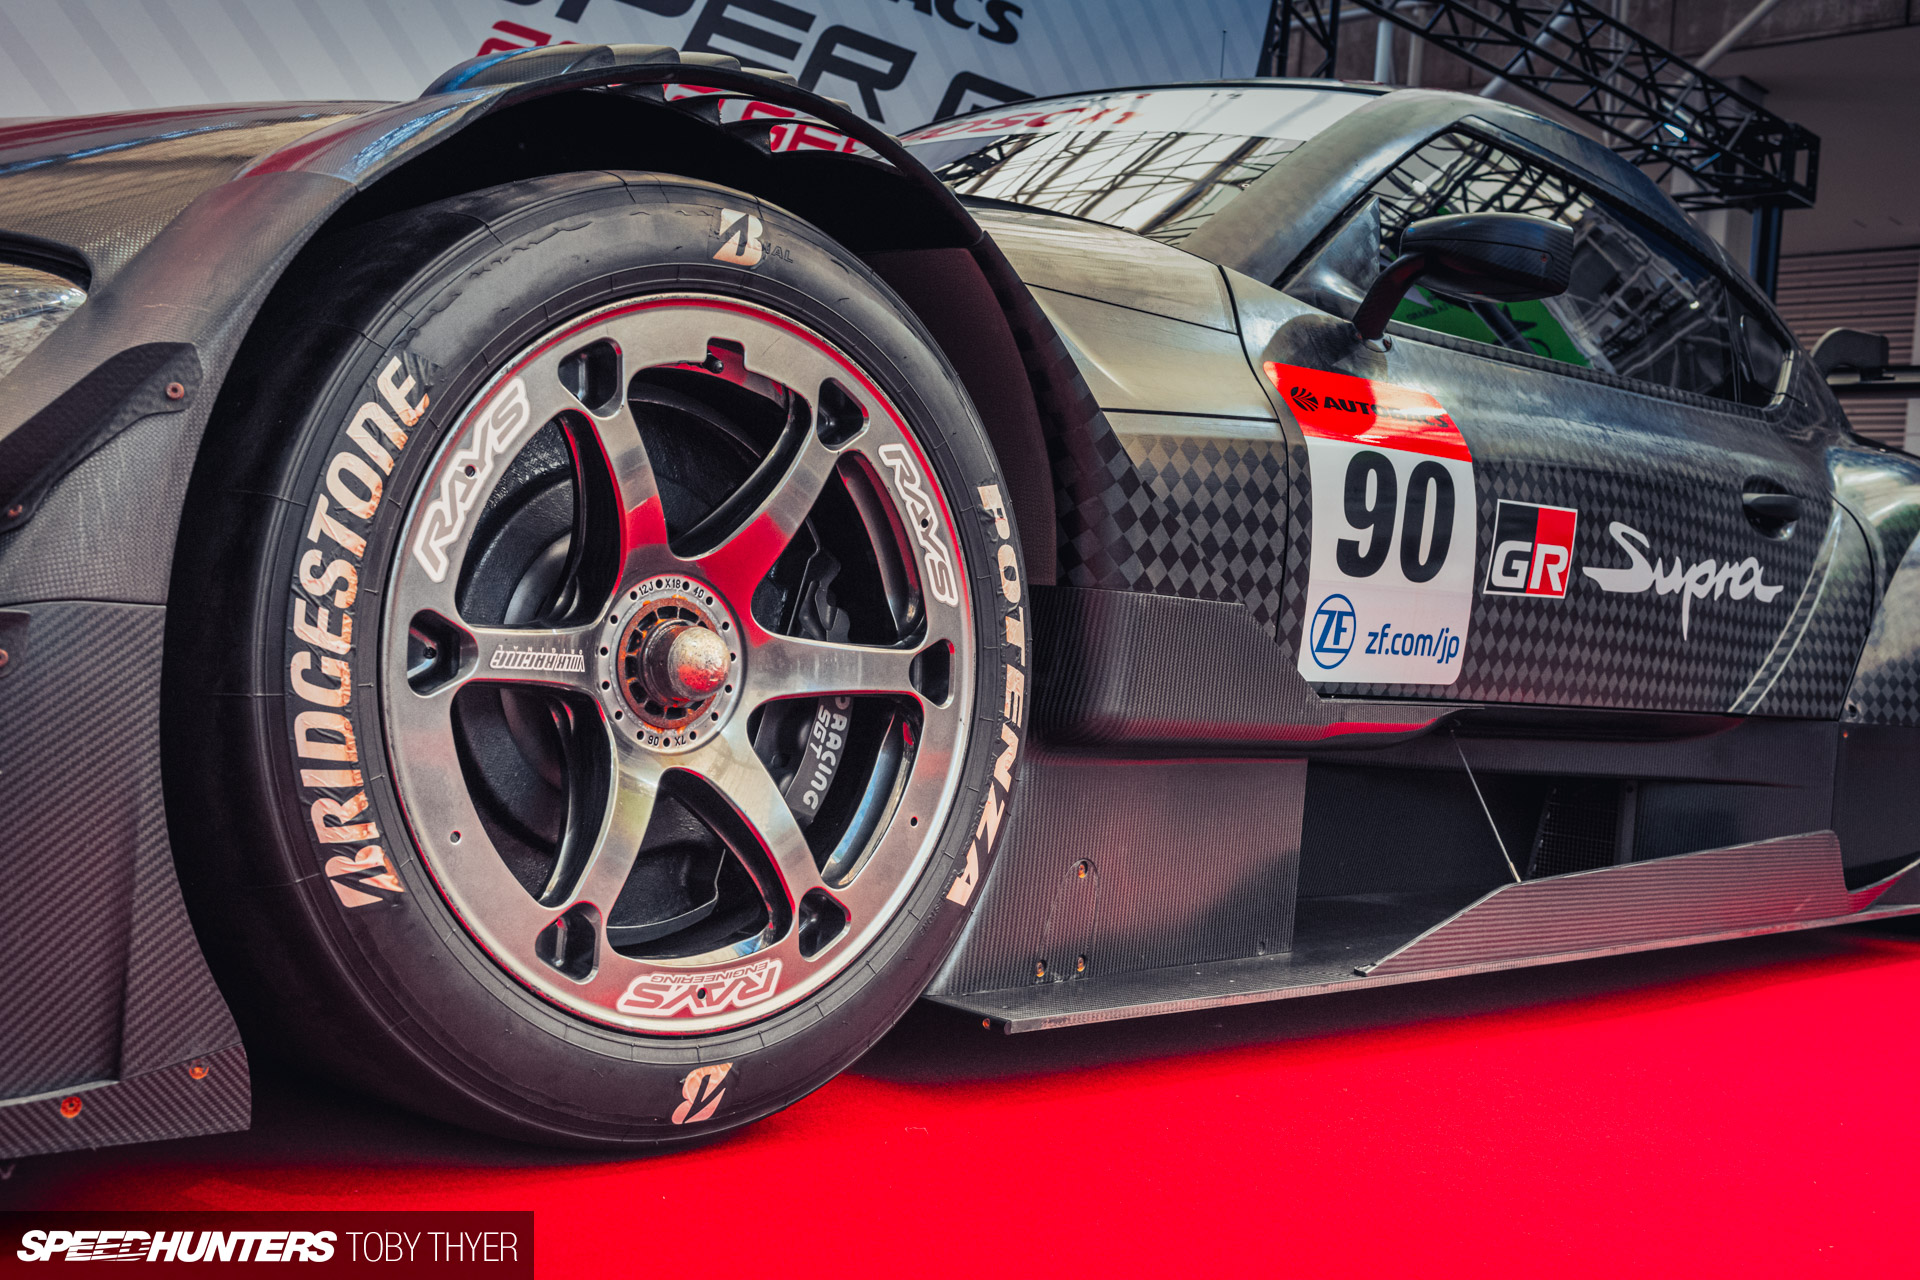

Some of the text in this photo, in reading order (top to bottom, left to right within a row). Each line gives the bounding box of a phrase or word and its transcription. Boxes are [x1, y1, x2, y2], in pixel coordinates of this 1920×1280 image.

[413, 376, 531, 583] RAYS
[878, 443, 960, 607] RAYS
[1336, 450, 1456, 583] 90
[1490, 540, 1569, 593] GR
[1583, 521, 1785, 641] Supra
[290, 356, 430, 908] BRIDGESTONE
[1313, 609, 1355, 654] ZF
[1365, 623, 1460, 664] zf.com/jp
[946, 484, 1026, 906] POTENZA
[803, 713, 848, 810] RACING
[617, 960, 783, 1016] RAYS
[650, 959, 769, 984] ENGINEERING
